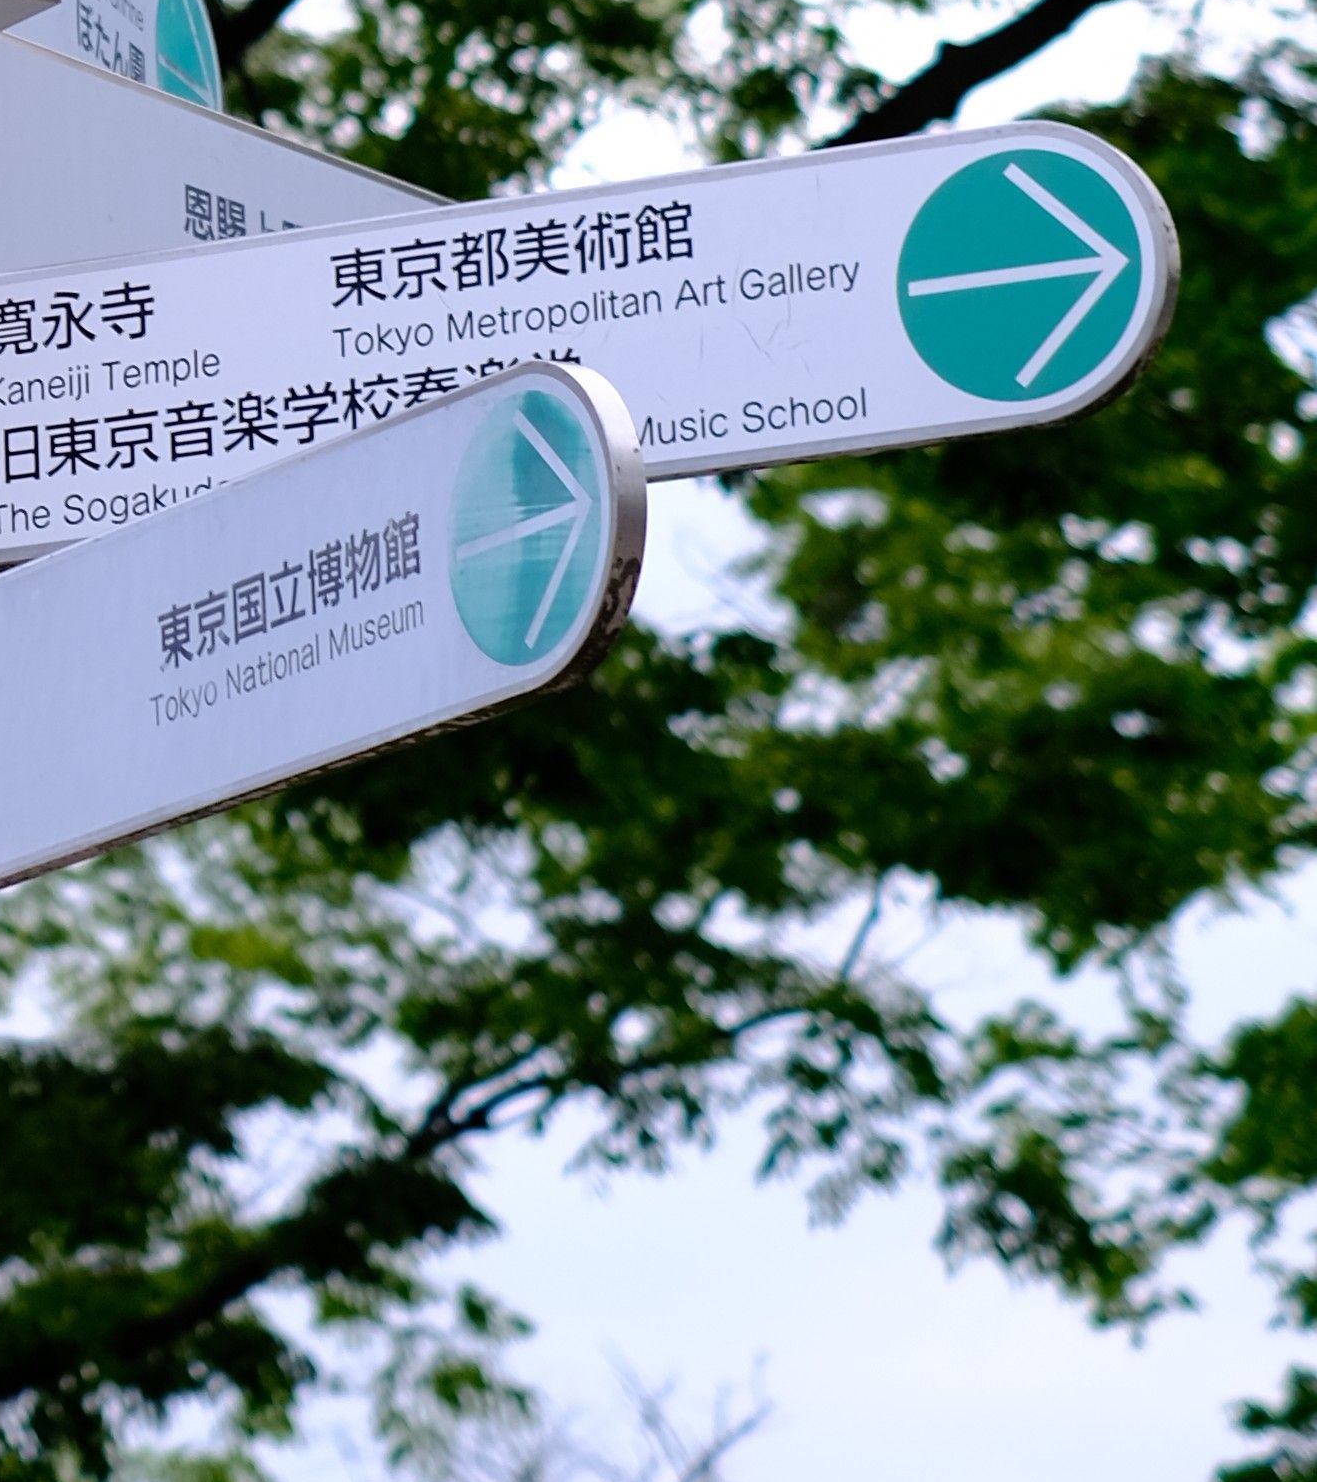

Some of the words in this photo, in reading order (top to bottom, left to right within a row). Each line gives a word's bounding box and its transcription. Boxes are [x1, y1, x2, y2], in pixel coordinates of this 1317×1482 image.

[184, 184, 303, 241] 恩賜
[330, 201, 692, 307] 東京都美術館
[333, 323, 433, 357] Tokyo
[448, 291, 661, 342] Metropolitan
[675, 276, 726, 309] Art
[740, 262, 859, 300] Gallery
[104, 350, 219, 390] Temple
[640, 409, 728, 446] Music
[743, 388, 866, 433] School
[158, 512, 420, 668] 東京国立博物館
[150, 682, 217, 726] Tokyo
[226, 634, 319, 698] National
[329, 601, 423, 659] Museum
